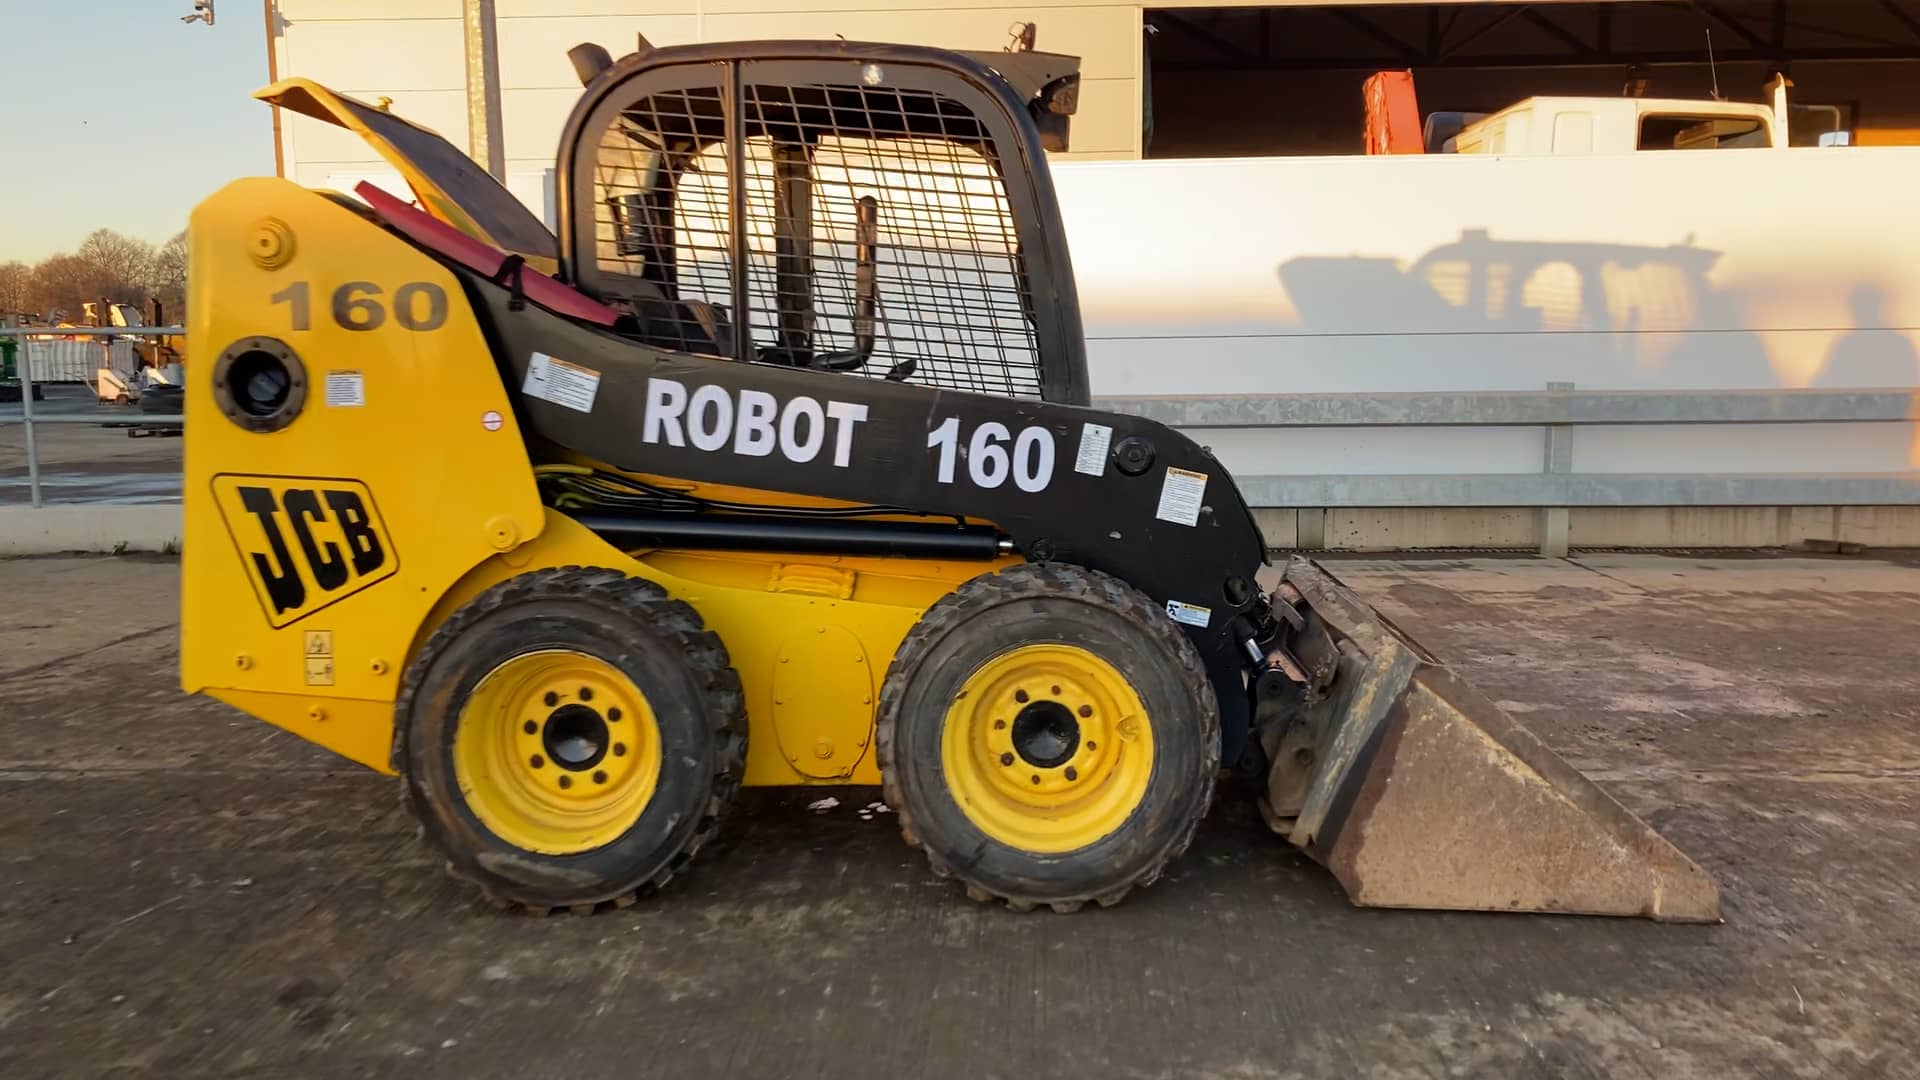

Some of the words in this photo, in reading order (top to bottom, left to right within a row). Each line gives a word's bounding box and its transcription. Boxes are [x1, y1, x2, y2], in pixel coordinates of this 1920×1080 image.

[271, 281, 449, 332] 160
[642, 377, 869, 468] ROBOT
[927, 415, 1055, 493] 160
[237, 486, 385, 615] JCB
